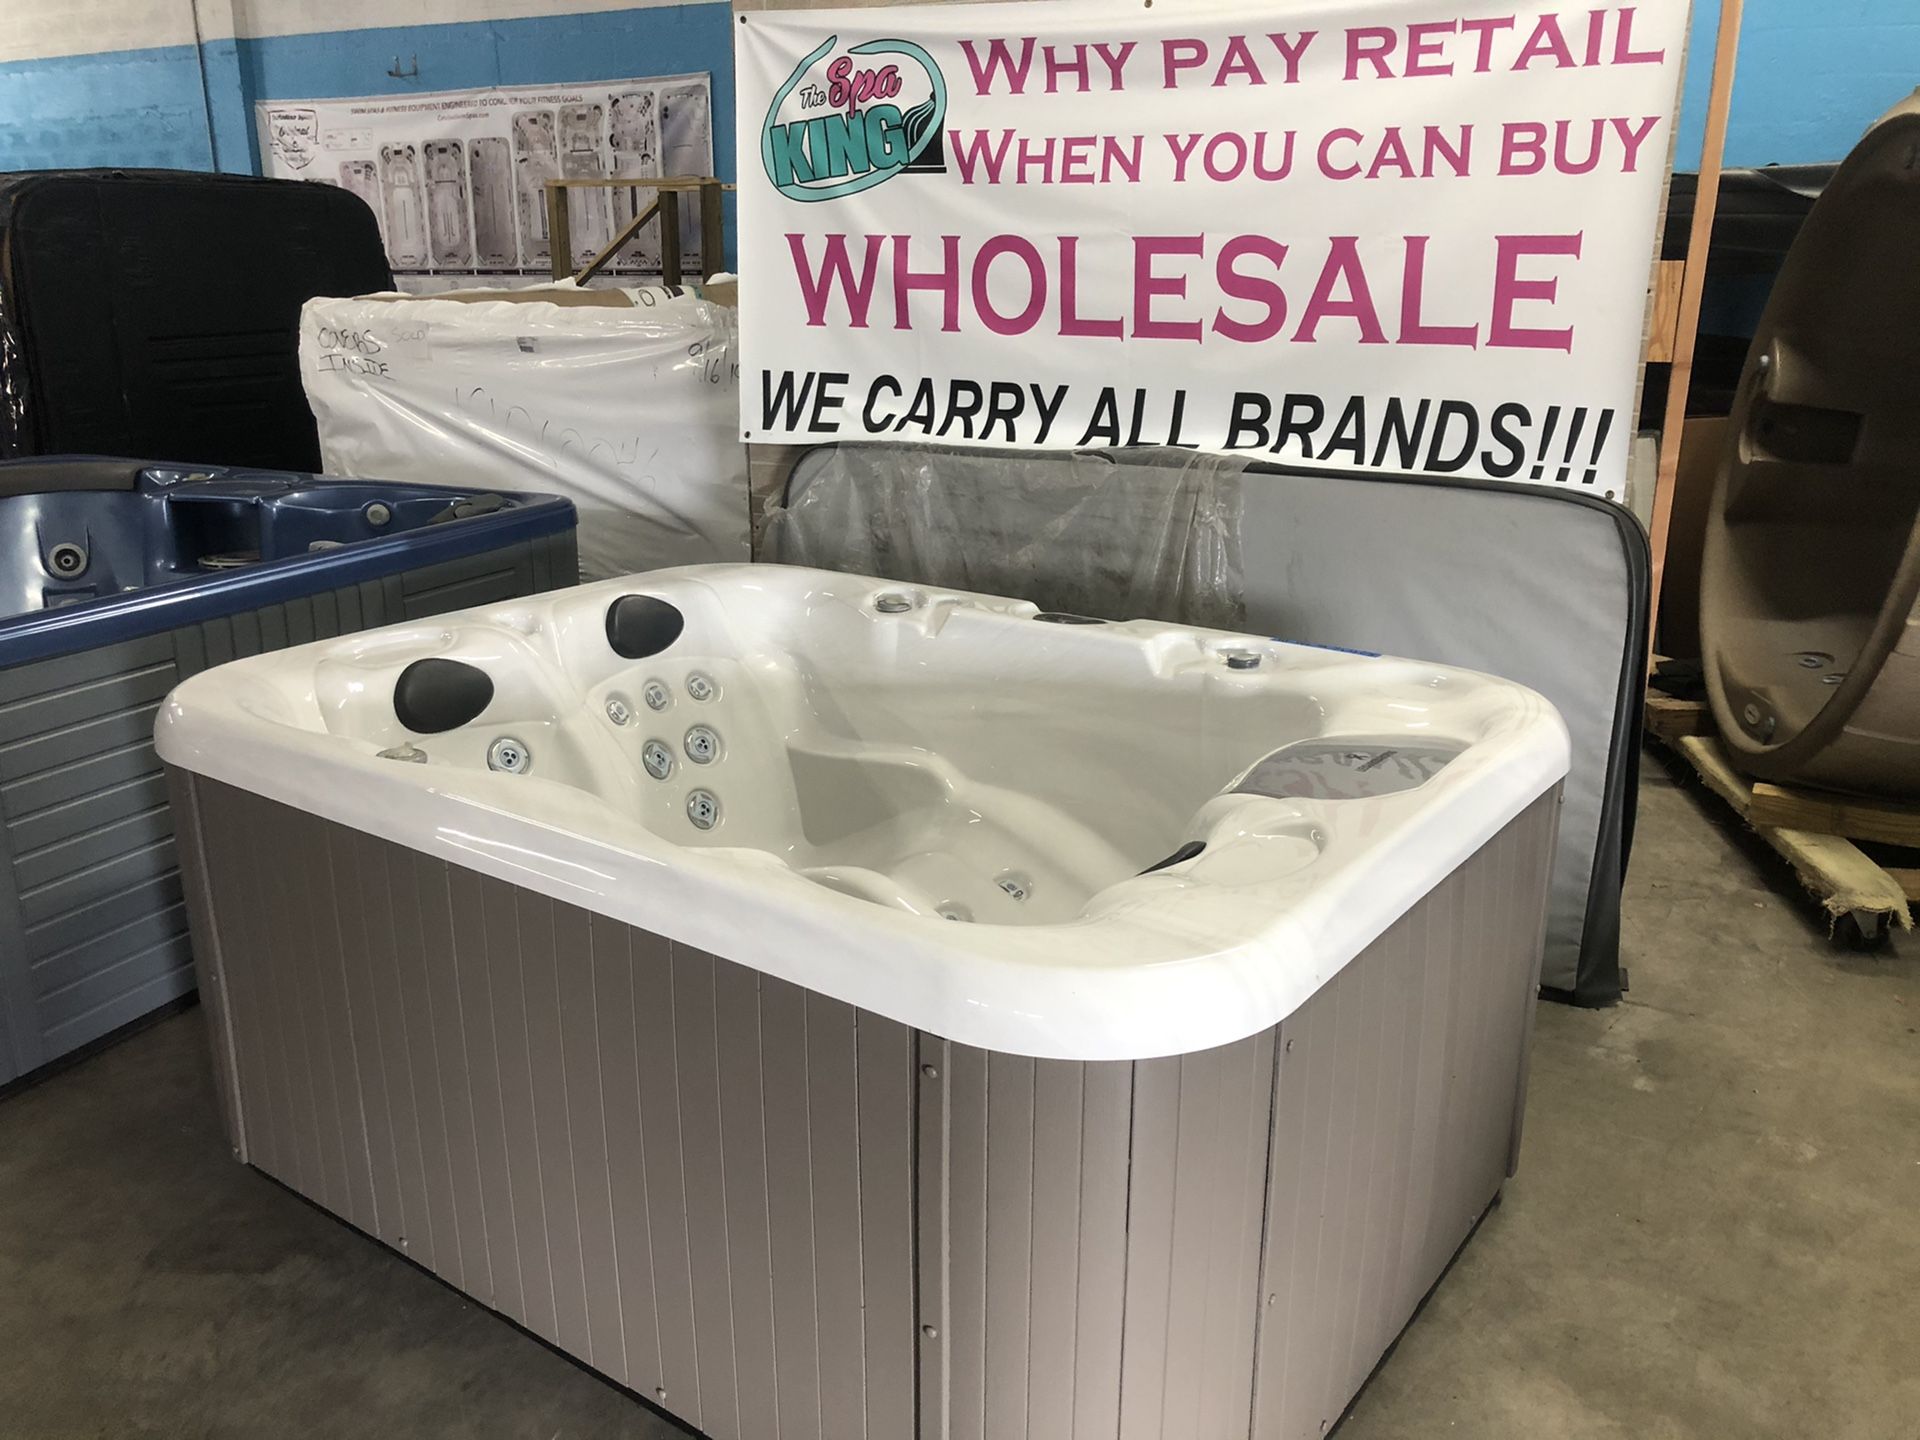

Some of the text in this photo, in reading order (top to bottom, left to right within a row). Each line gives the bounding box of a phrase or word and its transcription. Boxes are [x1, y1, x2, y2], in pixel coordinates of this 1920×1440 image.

[827, 56, 902, 119] Spa
[957, 8, 1664, 95] WHY PAY RETAIL
[799, 84, 827, 109] The
[770, 104, 910, 187] KING
[947, 117, 1660, 185] WHEN YOU CAN BUY
[784, 233, 1583, 354] WHOLESALE
[763, 370, 1615, 484] WE CARRY ALL BRANDS!!!
